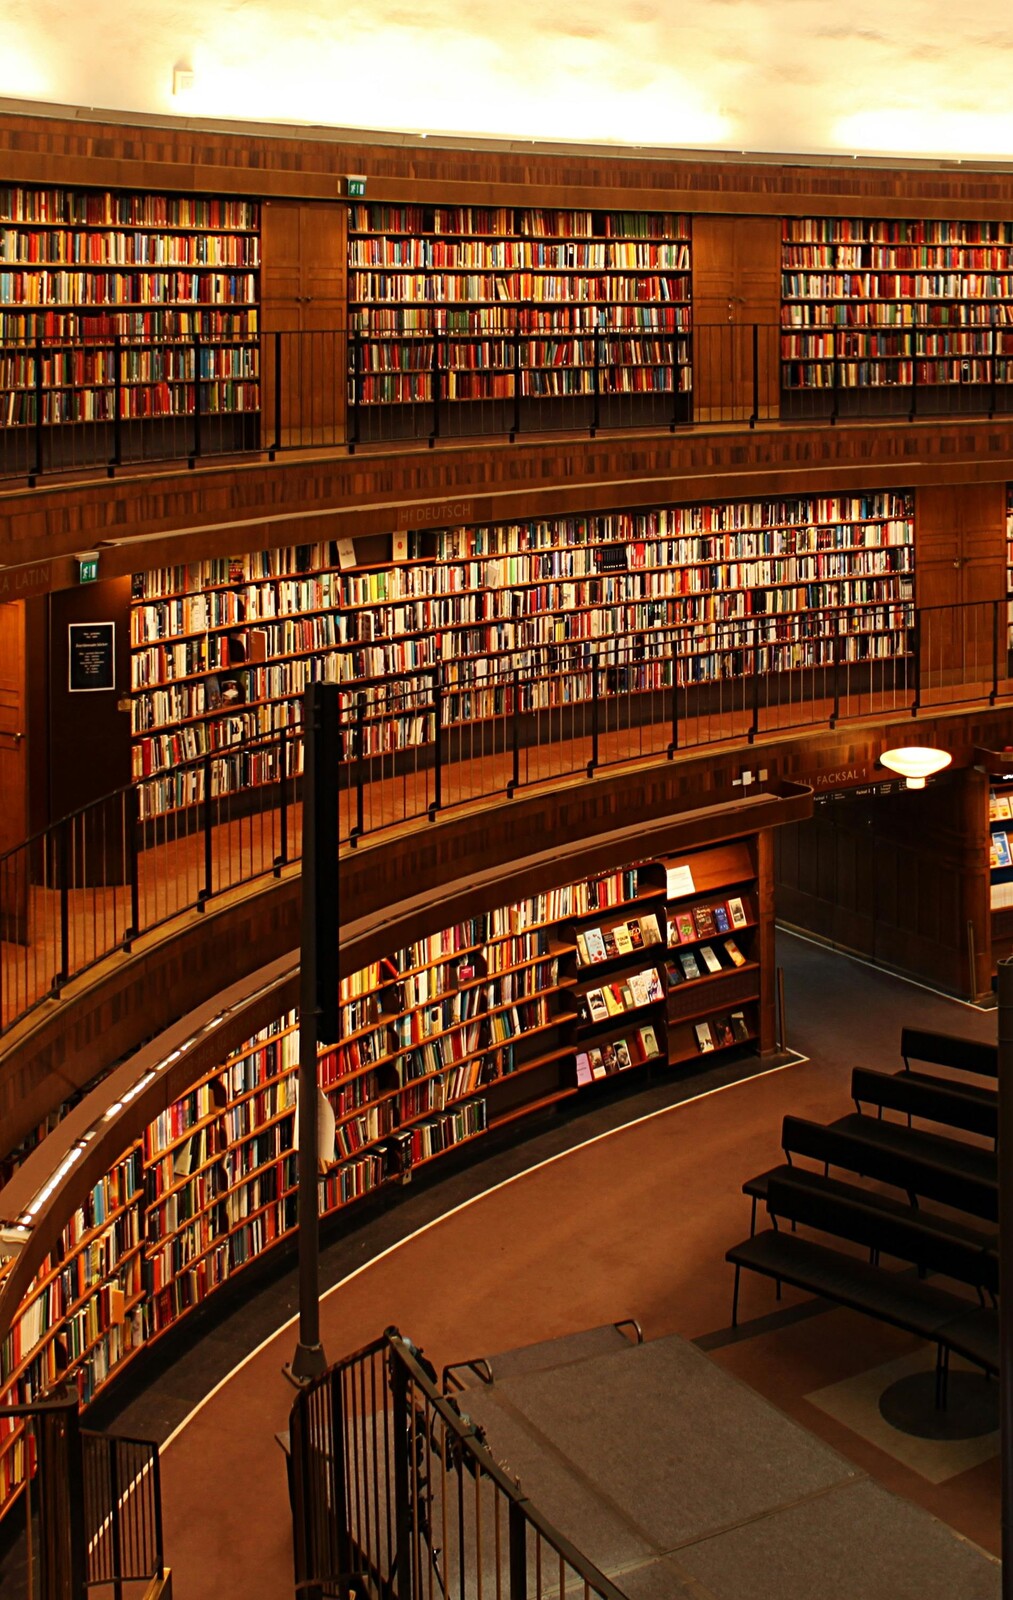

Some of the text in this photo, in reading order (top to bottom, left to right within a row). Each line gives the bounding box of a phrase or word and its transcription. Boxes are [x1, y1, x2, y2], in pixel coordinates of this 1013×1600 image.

[417, 503, 471, 522] DEUTSCH
[15, 566, 49, 590] LATIN
[816, 769, 859, 786] FACKSAL
[862, 767, 866, 777] 1
